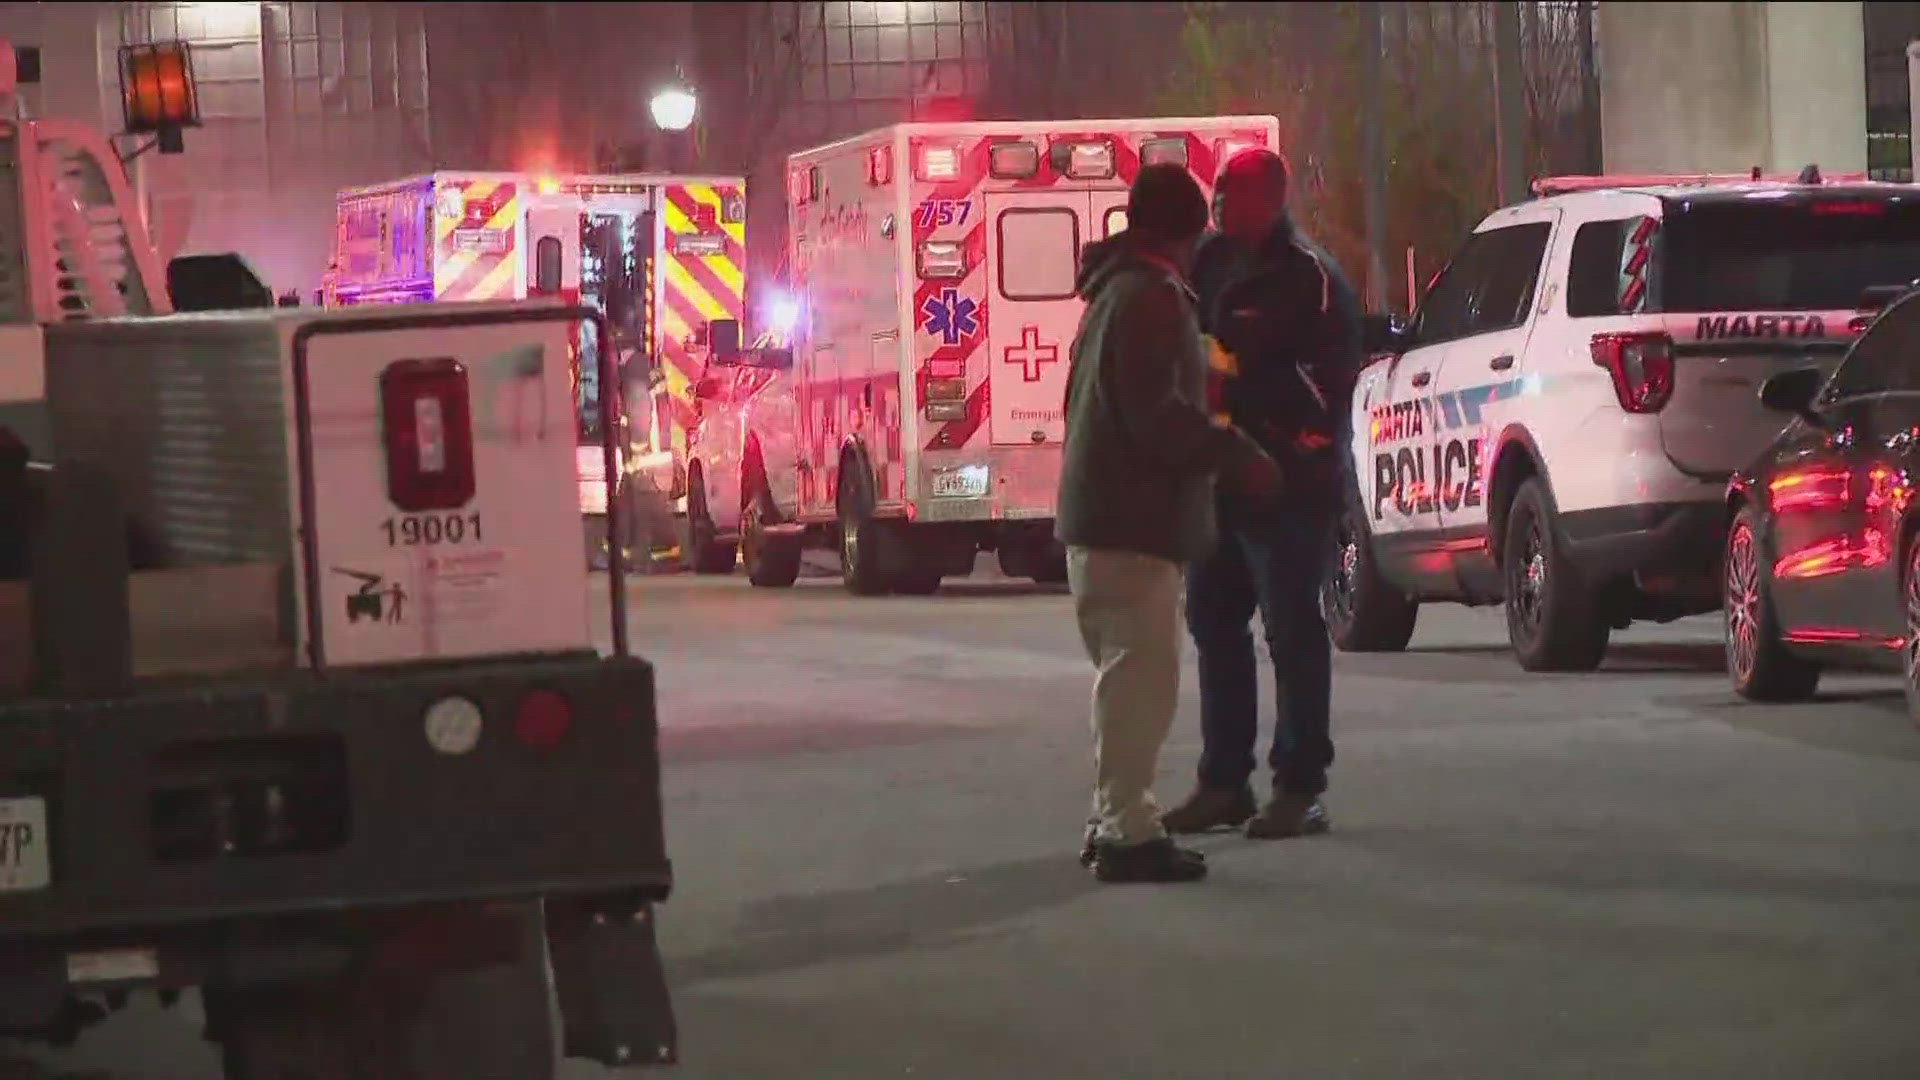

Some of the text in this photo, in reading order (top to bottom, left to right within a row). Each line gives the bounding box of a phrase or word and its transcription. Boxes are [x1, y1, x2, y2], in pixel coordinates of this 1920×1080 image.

[919, 199, 973, 227] 757
[1696, 314, 1825, 340] MARTA
[1373, 398, 1423, 446] MARTA
[1374, 438, 1482, 520] POLICE
[378, 511, 481, 547] 19001
